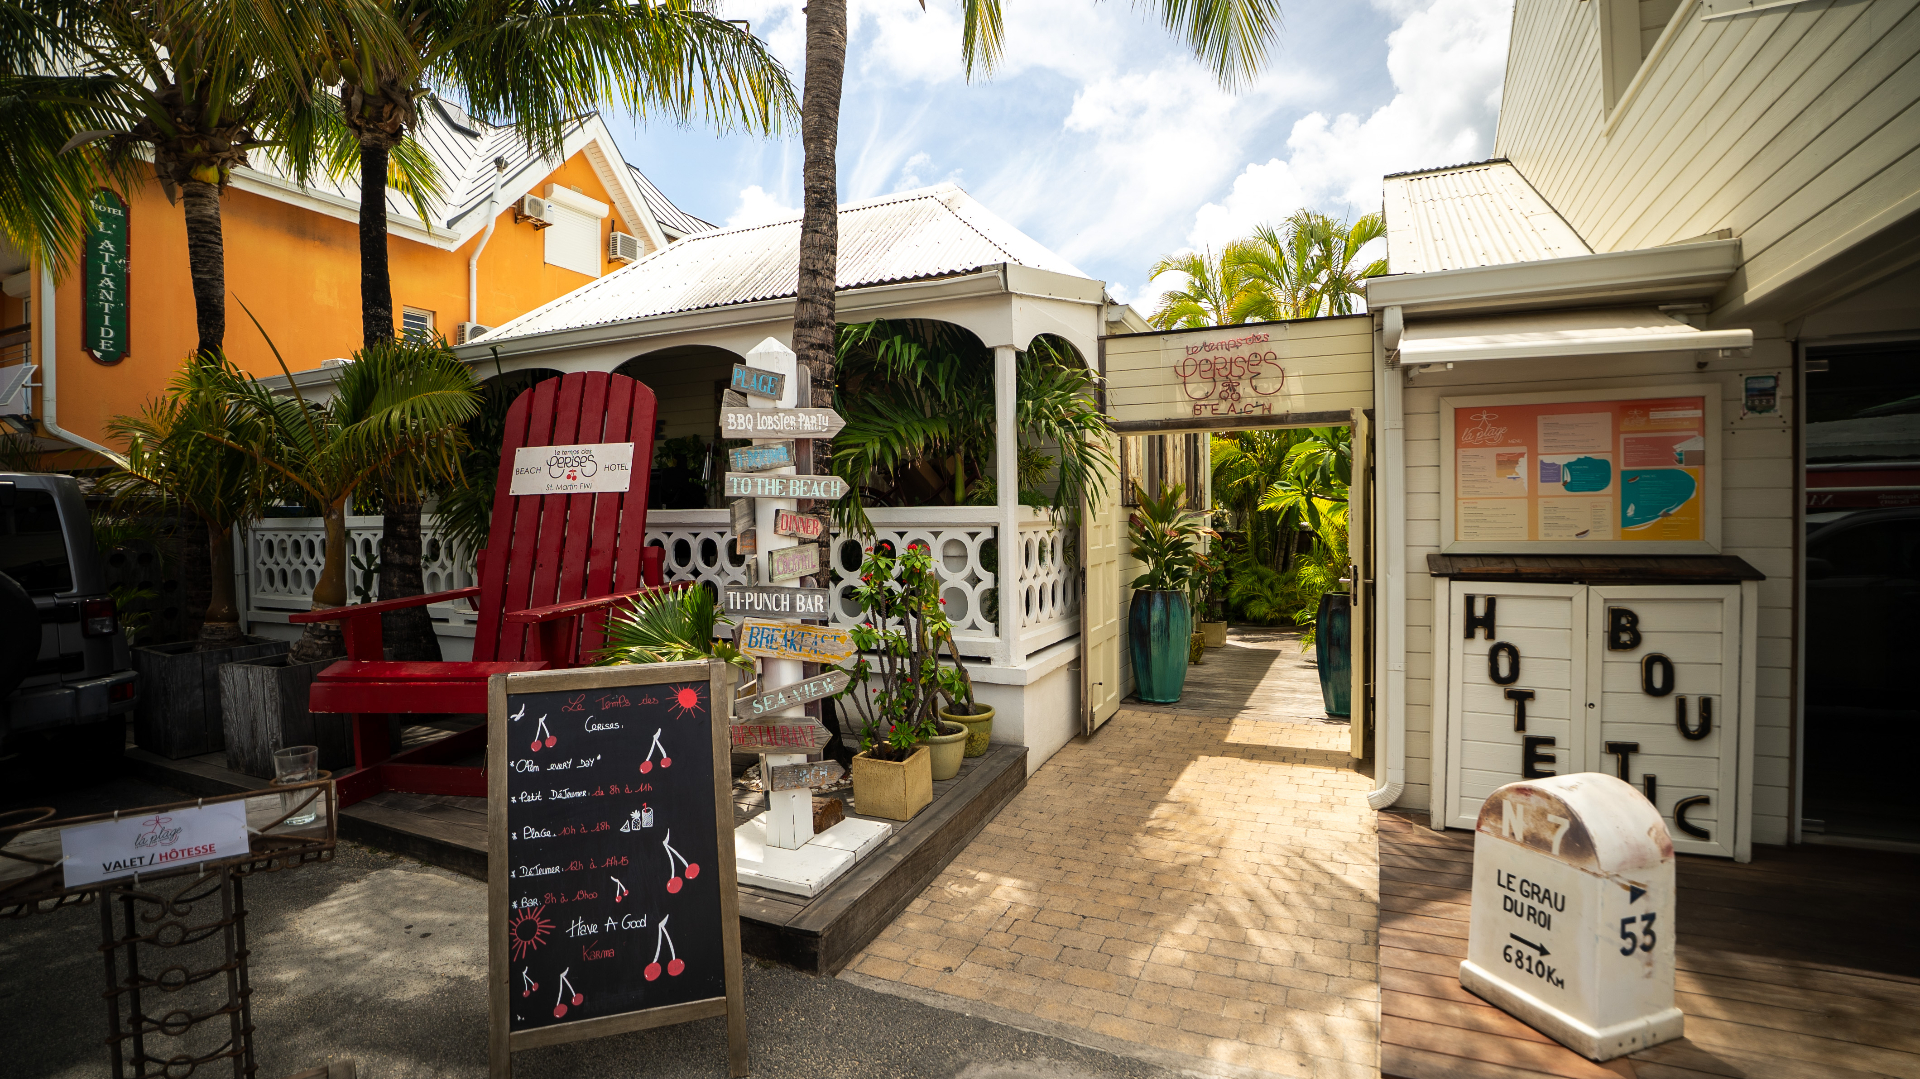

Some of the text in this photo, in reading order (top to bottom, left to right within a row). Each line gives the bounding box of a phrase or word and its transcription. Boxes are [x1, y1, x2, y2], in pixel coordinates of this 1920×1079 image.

[93, 204, 124, 216] HOTEL
[98, 221, 117, 351] L'ATLANTIDE
[732, 367, 778, 396] PLAGE
[1193, 402, 1272, 416] BEACH
[727, 413, 754, 432] BBQ
[515, 466, 542, 475] BEACH
[603, 463, 629, 471] HOTEL
[730, 477, 841, 498] TO THE BEACH
[780, 513, 820, 536] DINNER
[727, 591, 825, 613] TI-PUNCH BAR
[748, 626, 841, 655] BREAKFAST
[752, 675, 837, 714] SEA VIEW
[1463, 593, 1557, 779] HOTE
[562, 694, 586, 712] Le
[638, 694, 659, 706] des
[731, 724, 816, 748] RESTAURANT
[519, 791, 543, 802] Petit
[592, 786, 605, 796] de
[609, 783, 620, 795] 8h
[624, 785, 633, 796] à
[134, 826, 183, 847] la plage
[558, 825, 576, 836] 10h
[580, 824, 588, 834] à
[591, 821, 610, 832] 18h
[1501, 798, 1570, 856] N 7
[102, 843, 216, 872] VALET / HÔTESSE
[589, 858, 598, 869] à
[543, 893, 557, 905] 8h
[560, 893, 569, 903] à
[1497, 869, 1566, 913] LE GRAU
[604, 916, 619, 932] A
[621, 914, 647, 930] Good
[1503, 894, 1551, 931] DU ROI
[1619, 911, 1656, 956] 53
